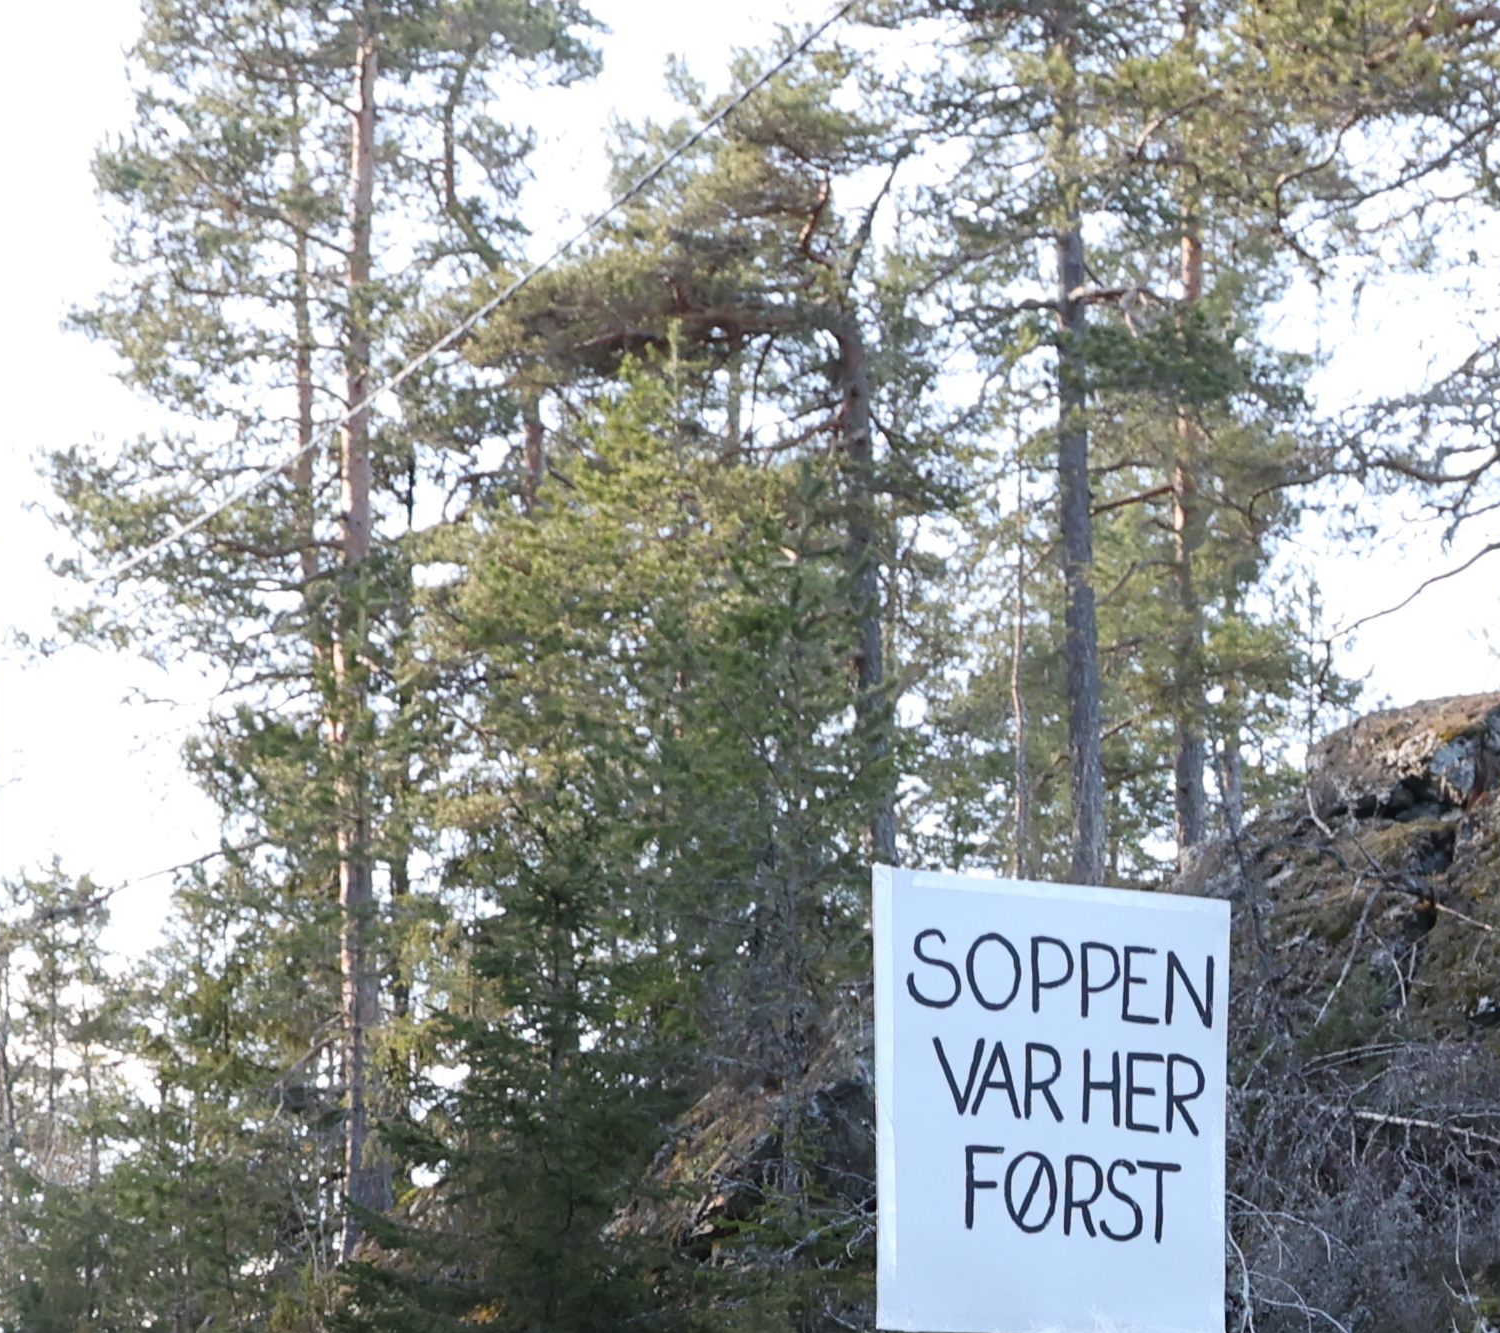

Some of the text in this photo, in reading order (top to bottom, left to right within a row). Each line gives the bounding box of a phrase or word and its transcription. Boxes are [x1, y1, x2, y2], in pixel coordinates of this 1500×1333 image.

[906, 928, 1215, 1029] SOPPEN
[932, 1036, 1206, 1137] VAR HER
[964, 1144, 1182, 1244] FØRST
